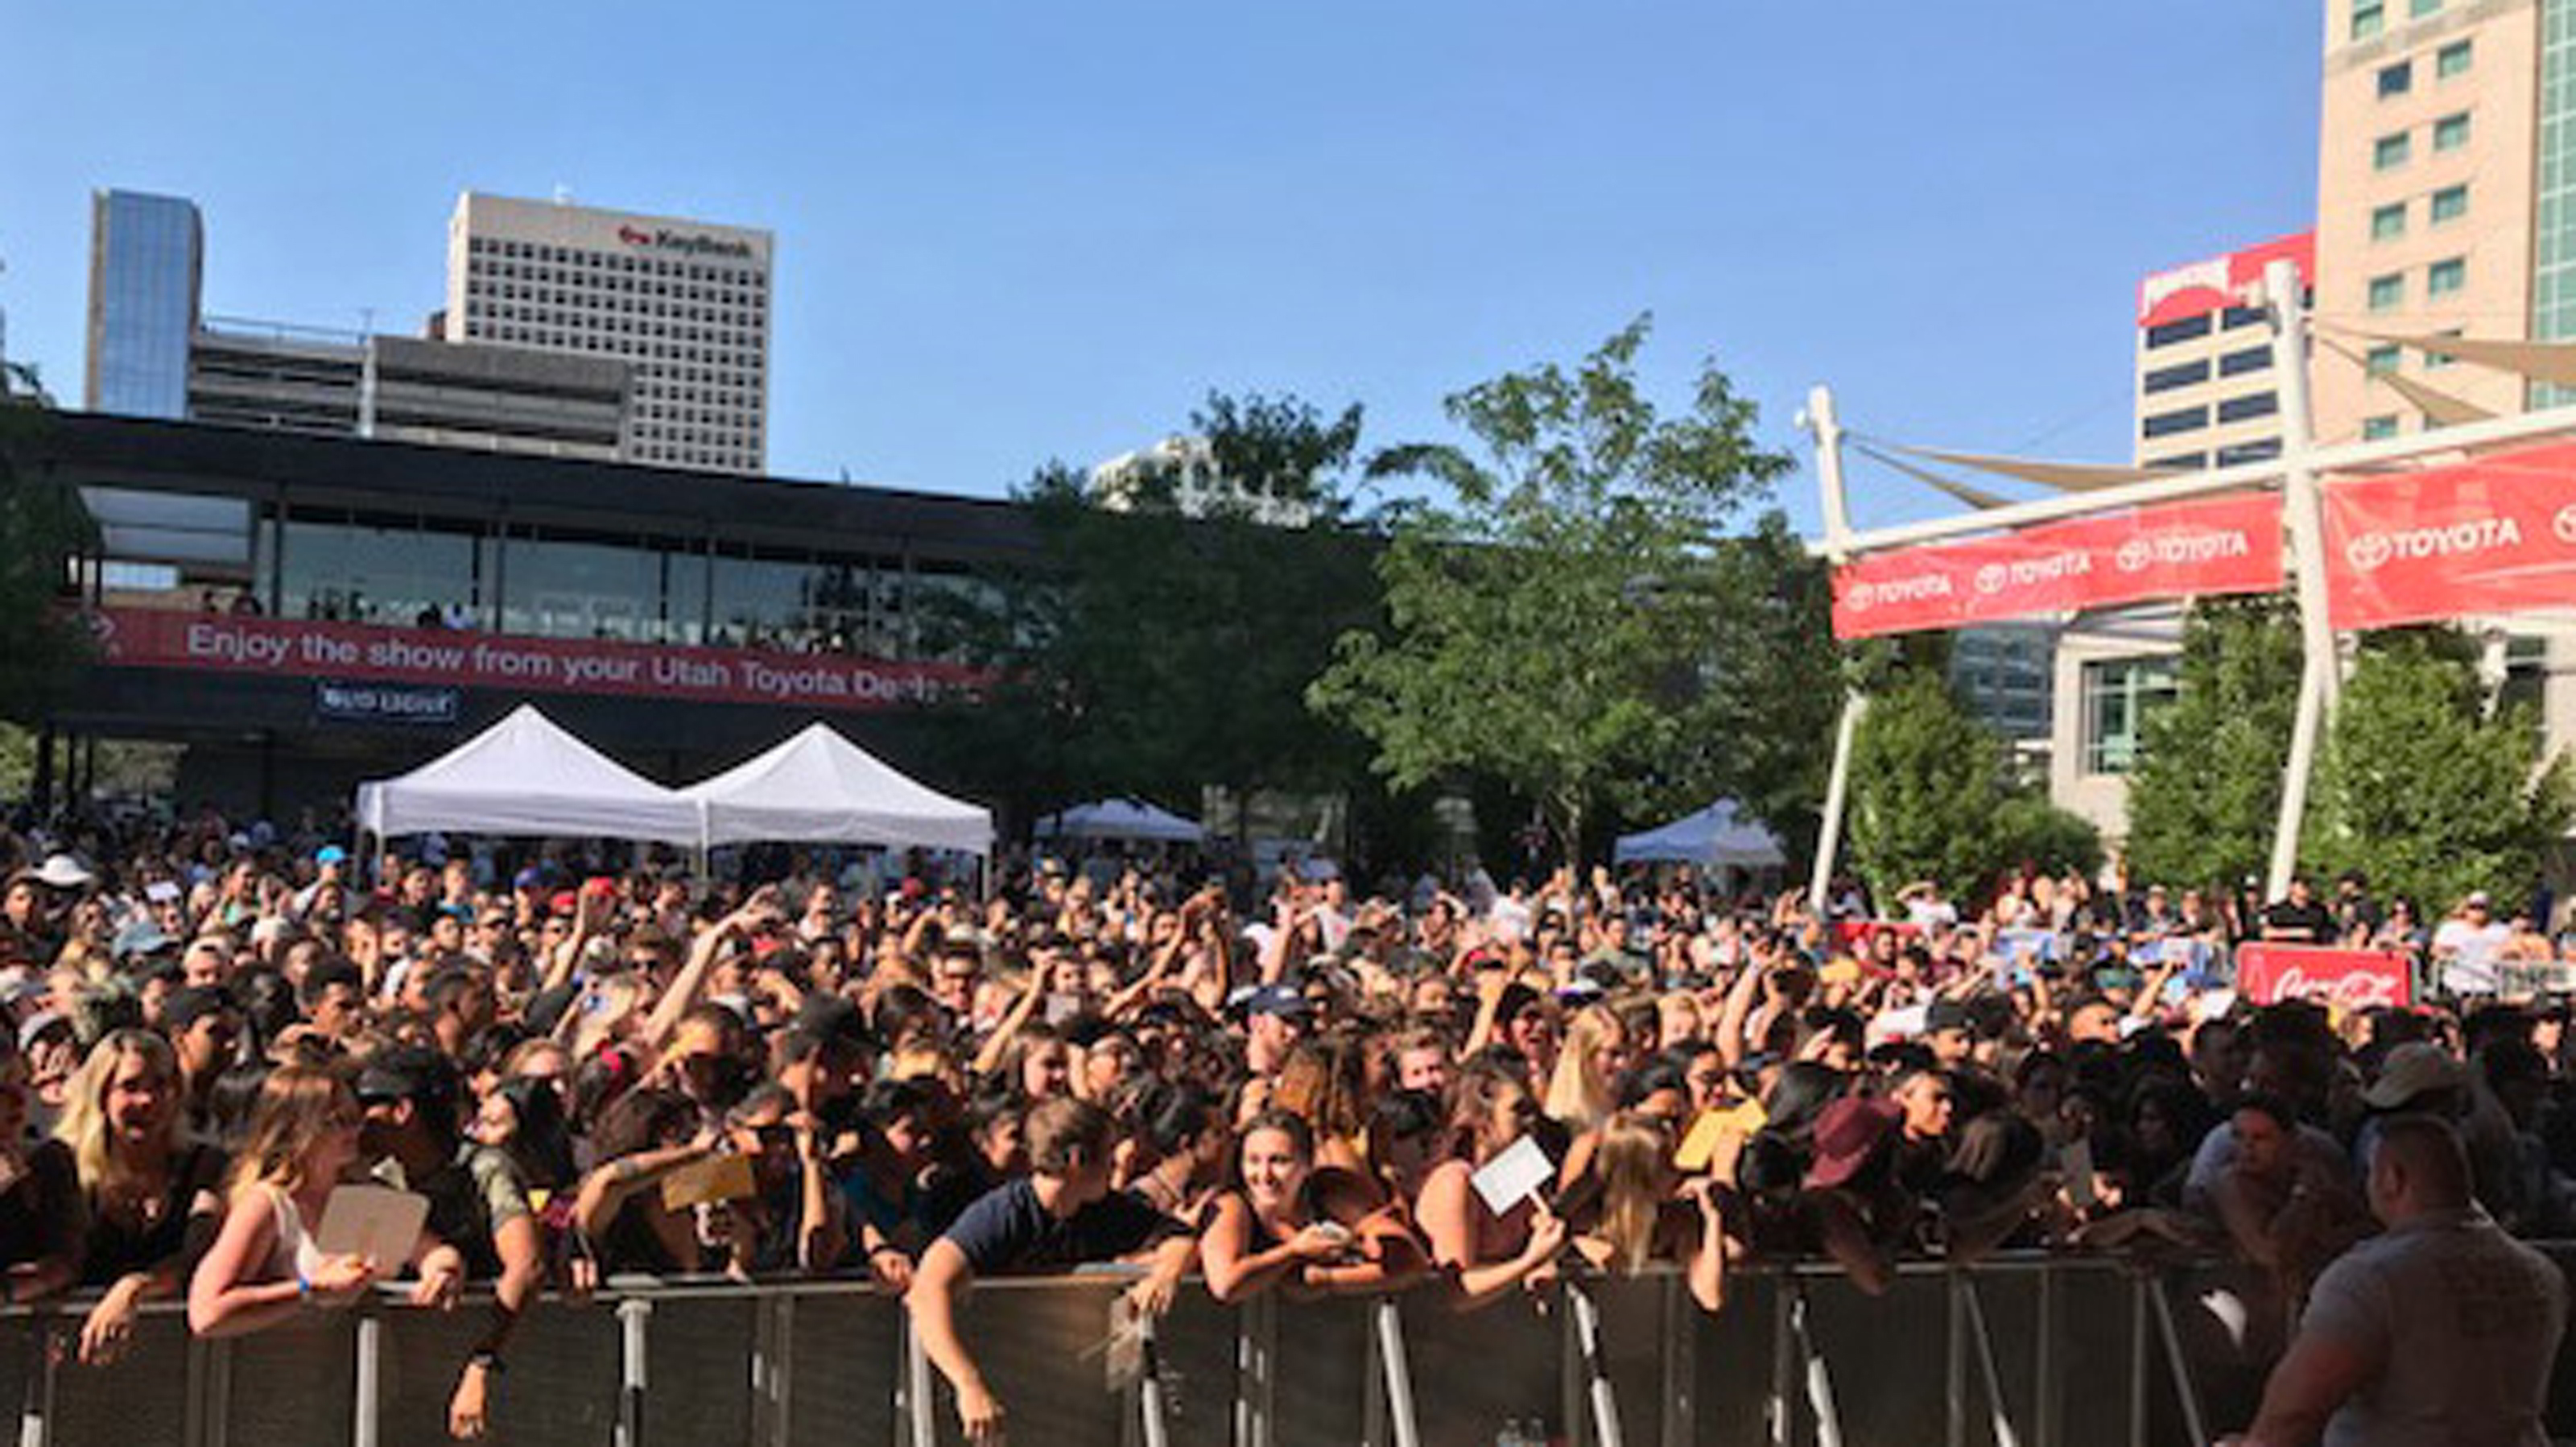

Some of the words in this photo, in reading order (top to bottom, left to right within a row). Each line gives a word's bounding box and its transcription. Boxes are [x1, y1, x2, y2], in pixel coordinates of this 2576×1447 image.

[656, 229, 750, 257] KeyBank
[1876, 573, 1951, 603] TOYOTA
[2009, 552, 2091, 584] TOYOTA
[2151, 529, 2249, 563] TOYOTA
[2392, 518, 2521, 559] TOYOTA
[187, 624, 291, 666] Enjoy
[300, 633, 359, 663] the
[368, 639, 465, 669] show
[473, 643, 552, 676] from
[562, 655, 639, 684] your
[651, 656, 730, 687] Utah
[740, 660, 847, 697] Toyota
